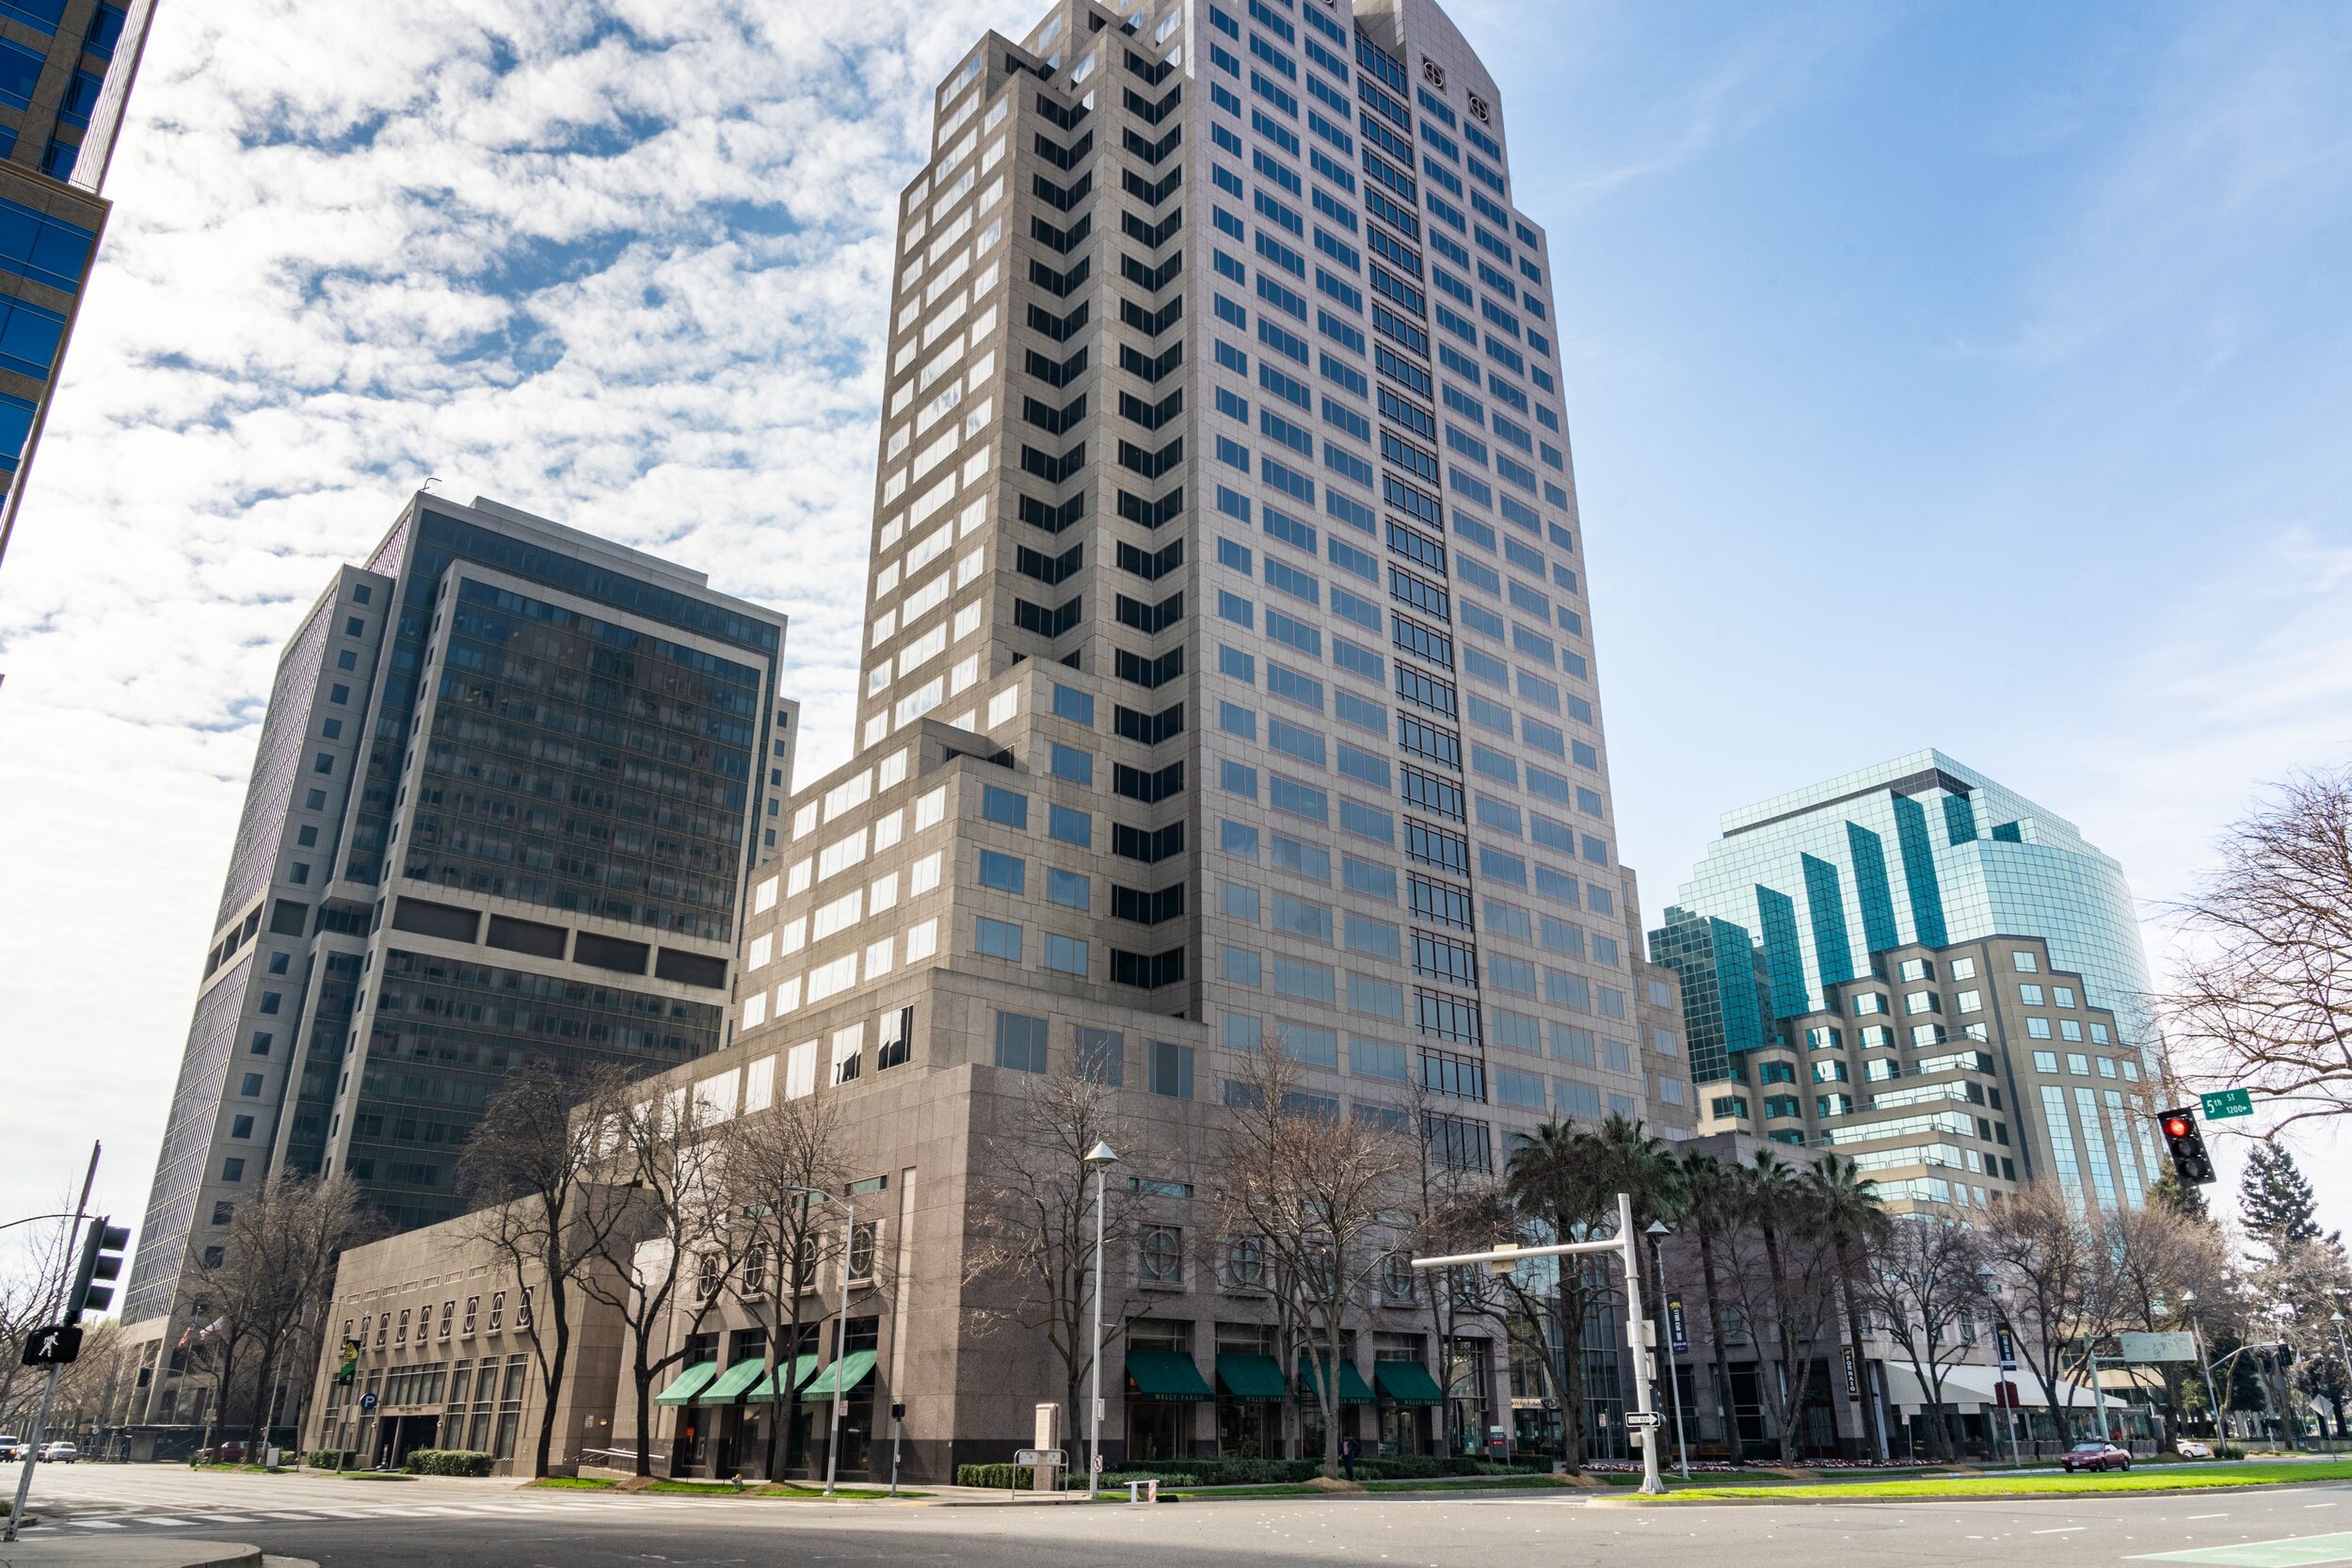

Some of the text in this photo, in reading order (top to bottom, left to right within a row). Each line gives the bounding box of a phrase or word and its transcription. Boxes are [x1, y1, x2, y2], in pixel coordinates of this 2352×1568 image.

[2206, 1099, 2222, 1113] 5th
[2226, 1105, 2243, 1113] 1200
[1846, 1356, 1855, 1392] FORNAIO
[364, 1396, 376, 1407] P
